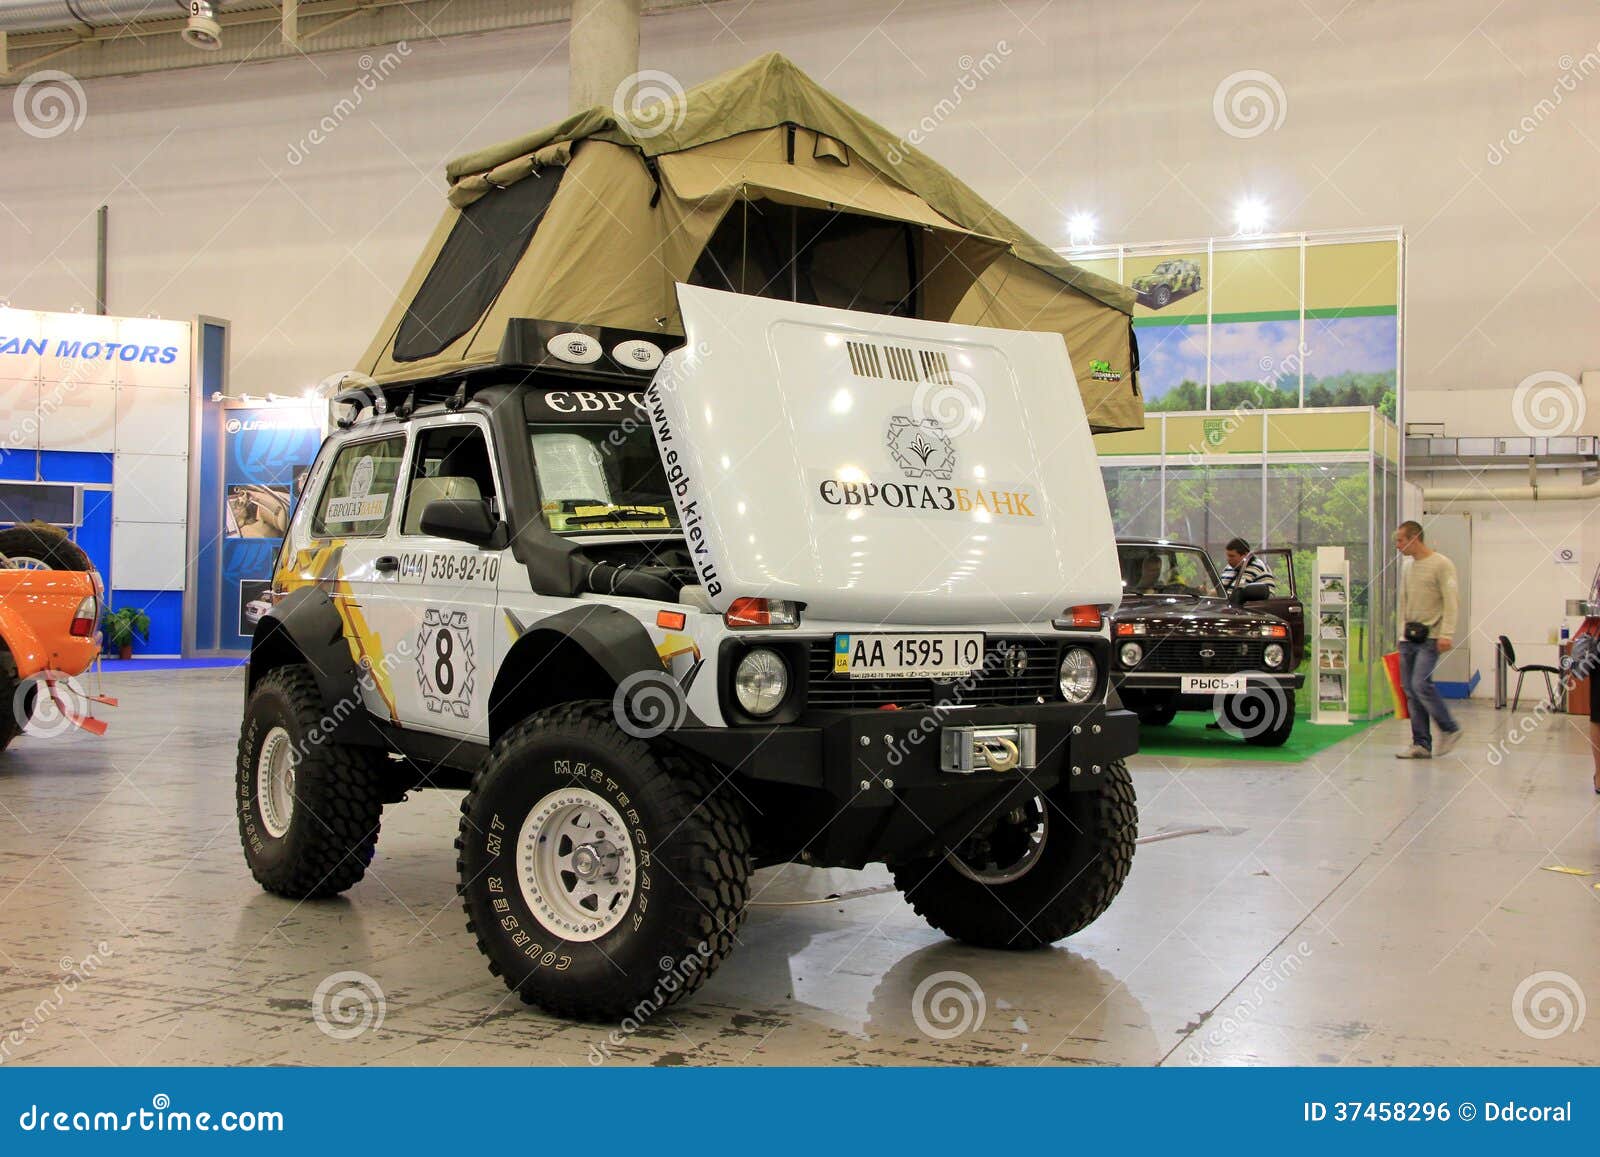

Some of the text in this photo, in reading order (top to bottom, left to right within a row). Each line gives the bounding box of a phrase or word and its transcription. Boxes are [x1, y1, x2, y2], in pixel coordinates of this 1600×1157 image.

[191, 2, 199, 16] 9
[55, 340, 178, 364] MOTORS
[647, 382, 722, 597] www.egb.kiev.ua
[819, 480, 1035, 517] ЄВРОГАЗБАНК
[398, 553, 499, 584] (044) 536-92-10
[435, 628, 454, 695] 8
[836, 659, 848, 667] UA
[851, 640, 885, 667] AA
[893, 639, 943, 666] 1595
[1190, 679, 1239, 689] РЫСЬ-1
[554, 760, 651, 932] MASTERCRAFT
[486, 814, 572, 971] COURSER MT
